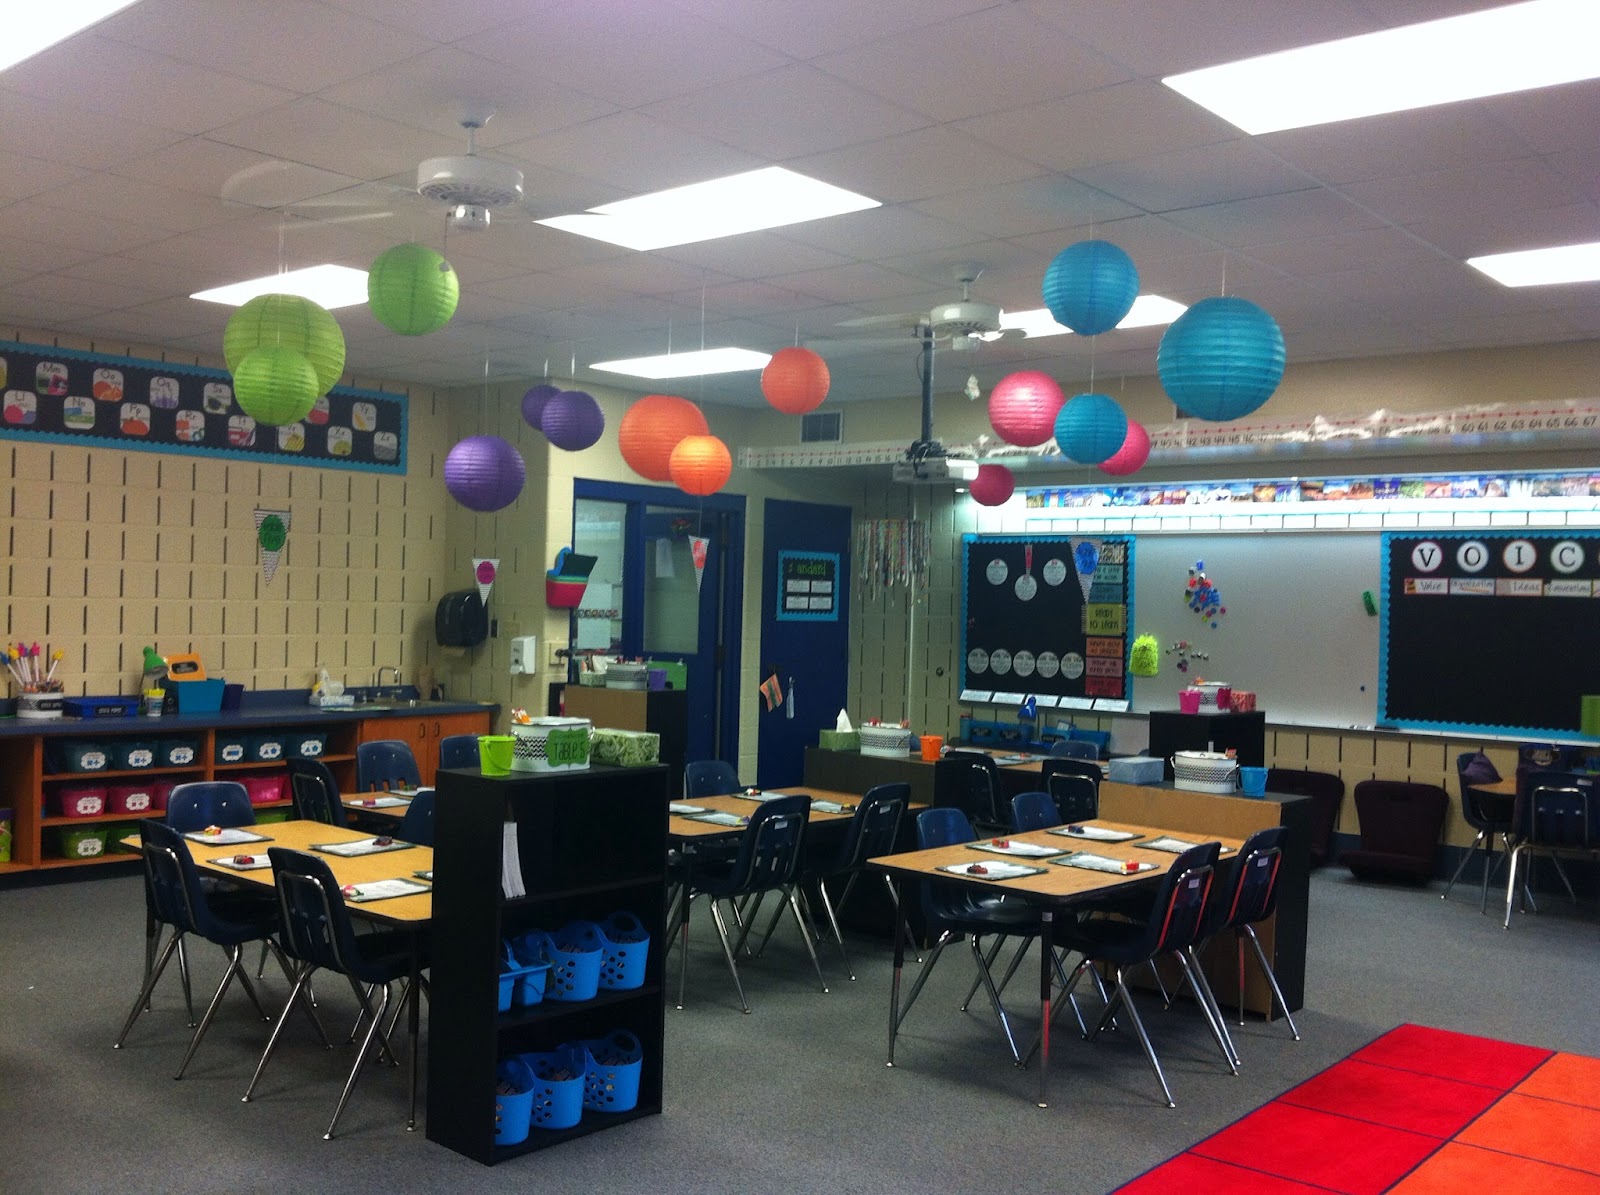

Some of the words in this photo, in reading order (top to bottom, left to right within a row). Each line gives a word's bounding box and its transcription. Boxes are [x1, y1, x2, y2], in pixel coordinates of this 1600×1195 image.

[101, 369, 115, 379] Oo
[1187, 438, 1198, 447] 42
[1200, 436, 1211, 446] 43
[1214, 435, 1225, 445] 44
[1229, 435, 1240, 444] 45
[1242, 434, 1253, 444] 46
[1461, 423, 1474, 433] 60
[1478, 422, 1488, 431] 61
[1494, 421, 1506, 431] 62
[1511, 420, 1524, 430] 63
[1529, 419, 1541, 429] 64
[1547, 418, 1560, 428] 65
[1564, 417, 1578, 427] 66
[1583, 416, 1597, 426] 67
[1418, 548, 1435, 568] V
[1464, 546, 1481, 567] O
[1515, 545, 1525, 566] I
[1558, 546, 1577, 568] C
